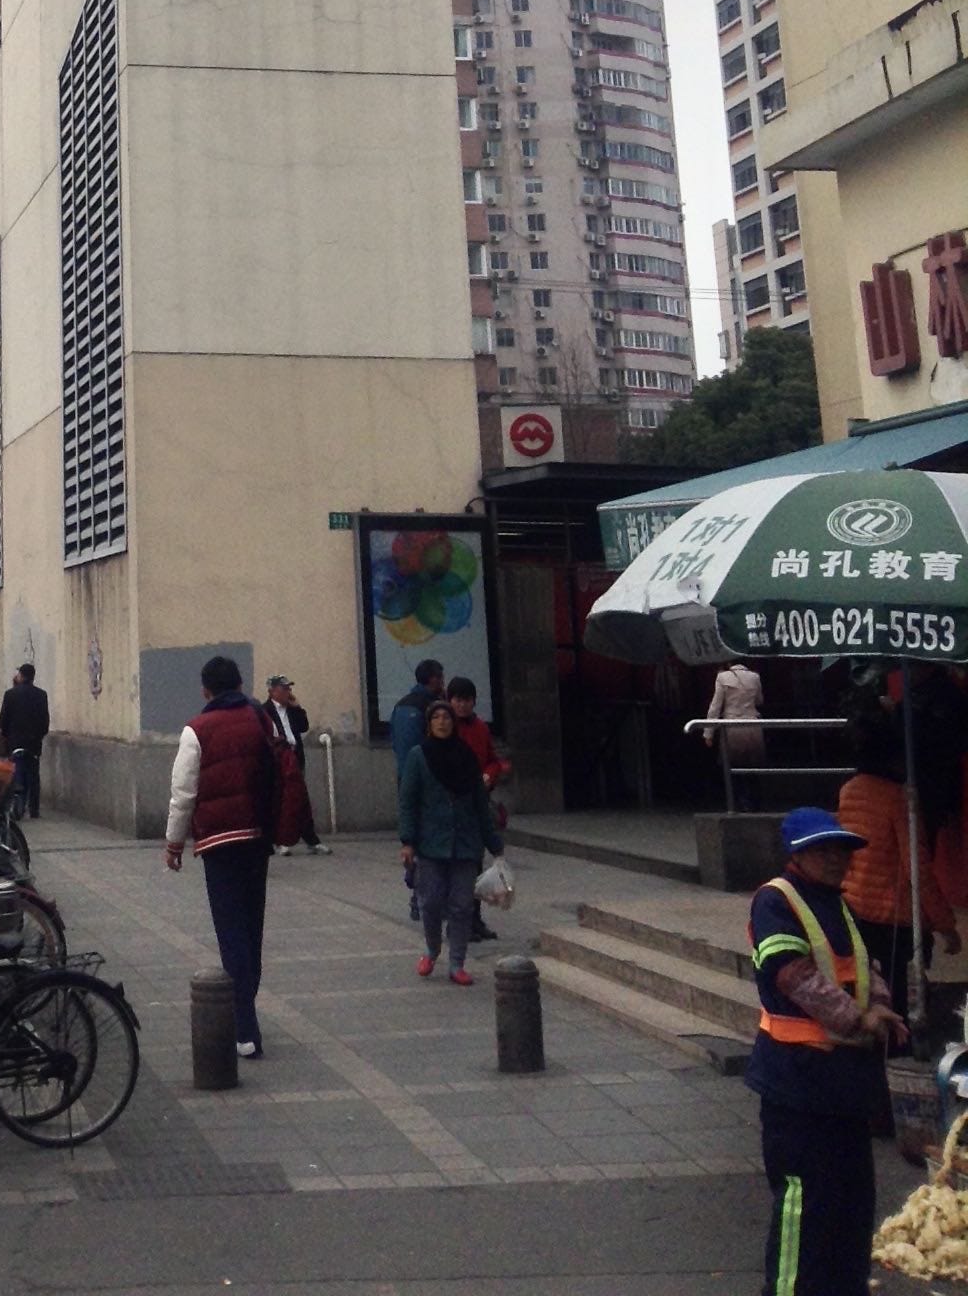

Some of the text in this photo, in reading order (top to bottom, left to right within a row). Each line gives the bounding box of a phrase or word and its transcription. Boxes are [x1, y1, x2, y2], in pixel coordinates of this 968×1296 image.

[679, 513, 752, 546] 1对1
[771, 549, 963, 581] 尚孔教育
[774, 608, 956, 651] 400-621-5553
